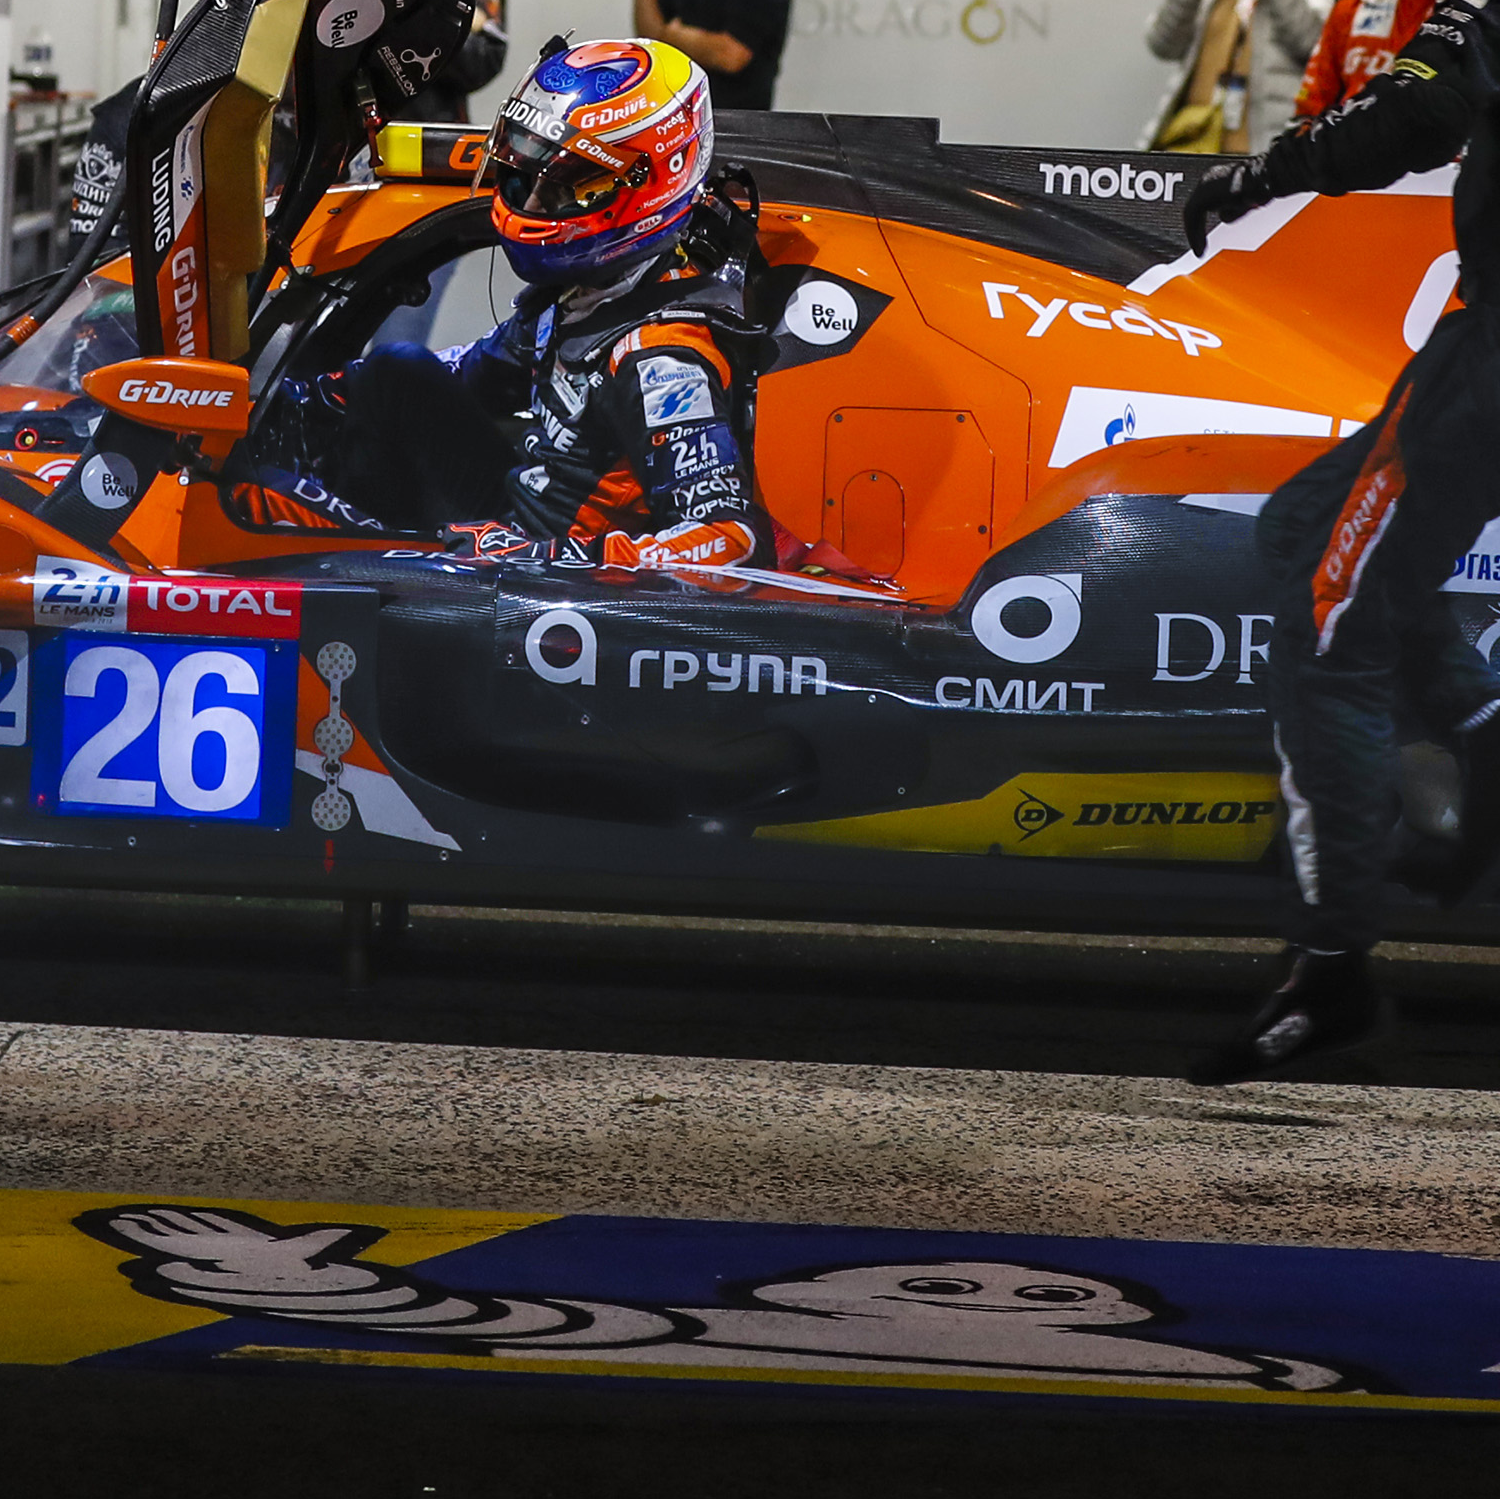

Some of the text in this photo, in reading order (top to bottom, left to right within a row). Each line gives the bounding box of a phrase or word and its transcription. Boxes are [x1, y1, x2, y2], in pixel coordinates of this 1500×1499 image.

[330, 13, 346, 49] Well
[344, 9, 358, 31] Be
[500, 100, 566, 142] UDING
[152, 147, 173, 253] LUDING
[1039, 162, 1185, 203] motor
[636, 216, 660, 232] BELL
[811, 304, 837, 318] Be
[812, 316, 855, 333] Well
[102, 473, 122, 486] Be
[39, 604, 116, 619] LE MANS
[136, 579, 293, 617] TOTAL
[628, 647, 829, 697] групп
[934, 675, 1106, 713] СМИТ
[59, 645, 262, 813] 26
[1072, 800, 1276, 828] DUNLOP
